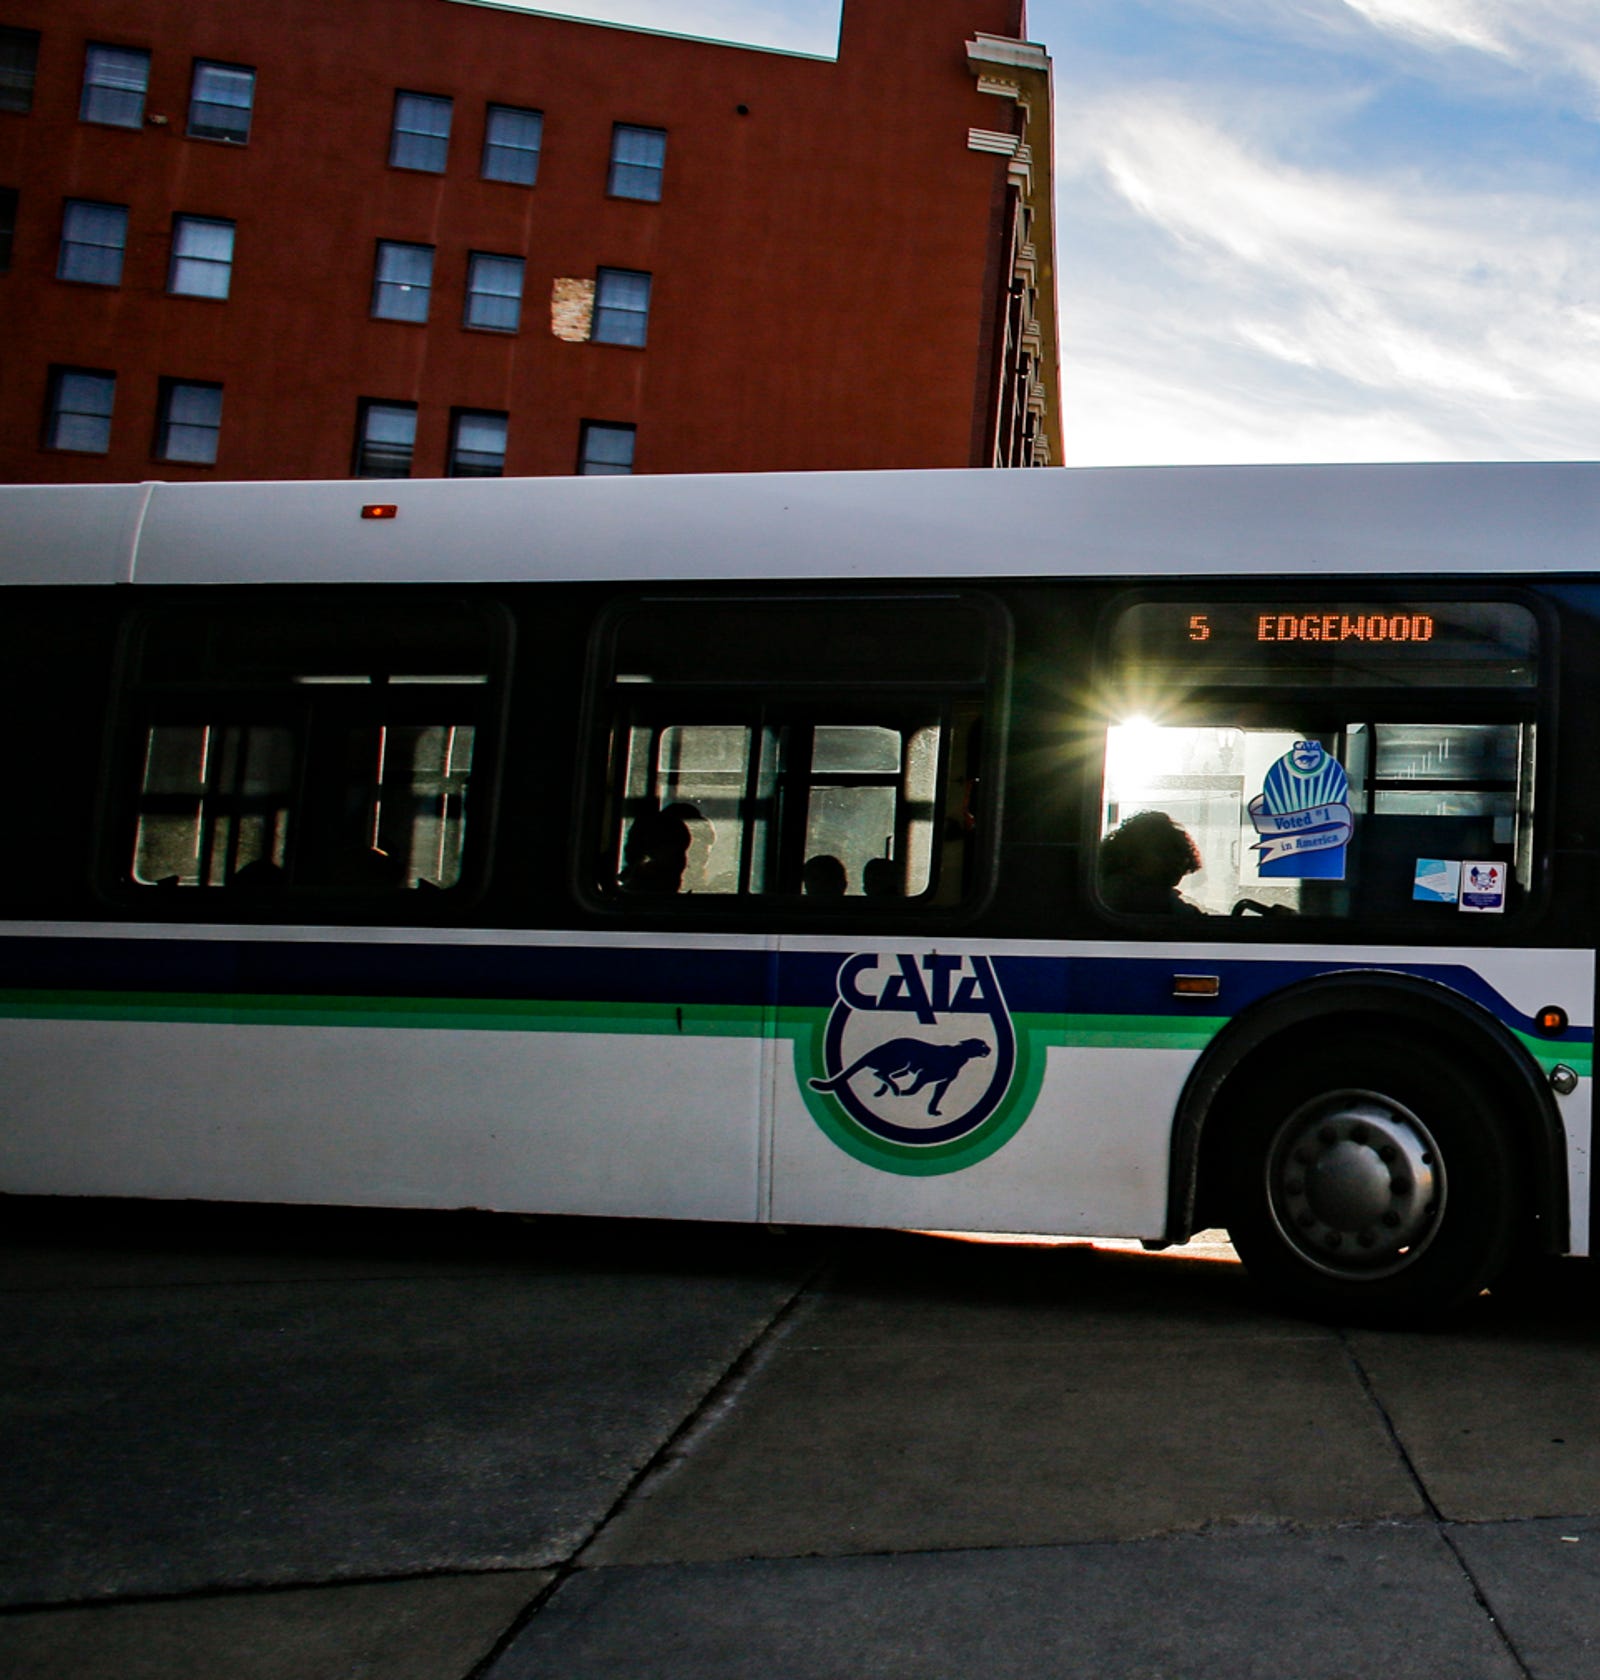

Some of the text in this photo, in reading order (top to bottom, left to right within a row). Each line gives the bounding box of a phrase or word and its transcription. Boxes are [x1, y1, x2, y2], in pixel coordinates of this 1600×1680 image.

[1188, 615, 1433, 642] 5 EDGEWOOD
[1274, 813, 1313, 830] Voted
[1281, 835, 1339, 851] in America
[838, 952, 1004, 1024] CATA
